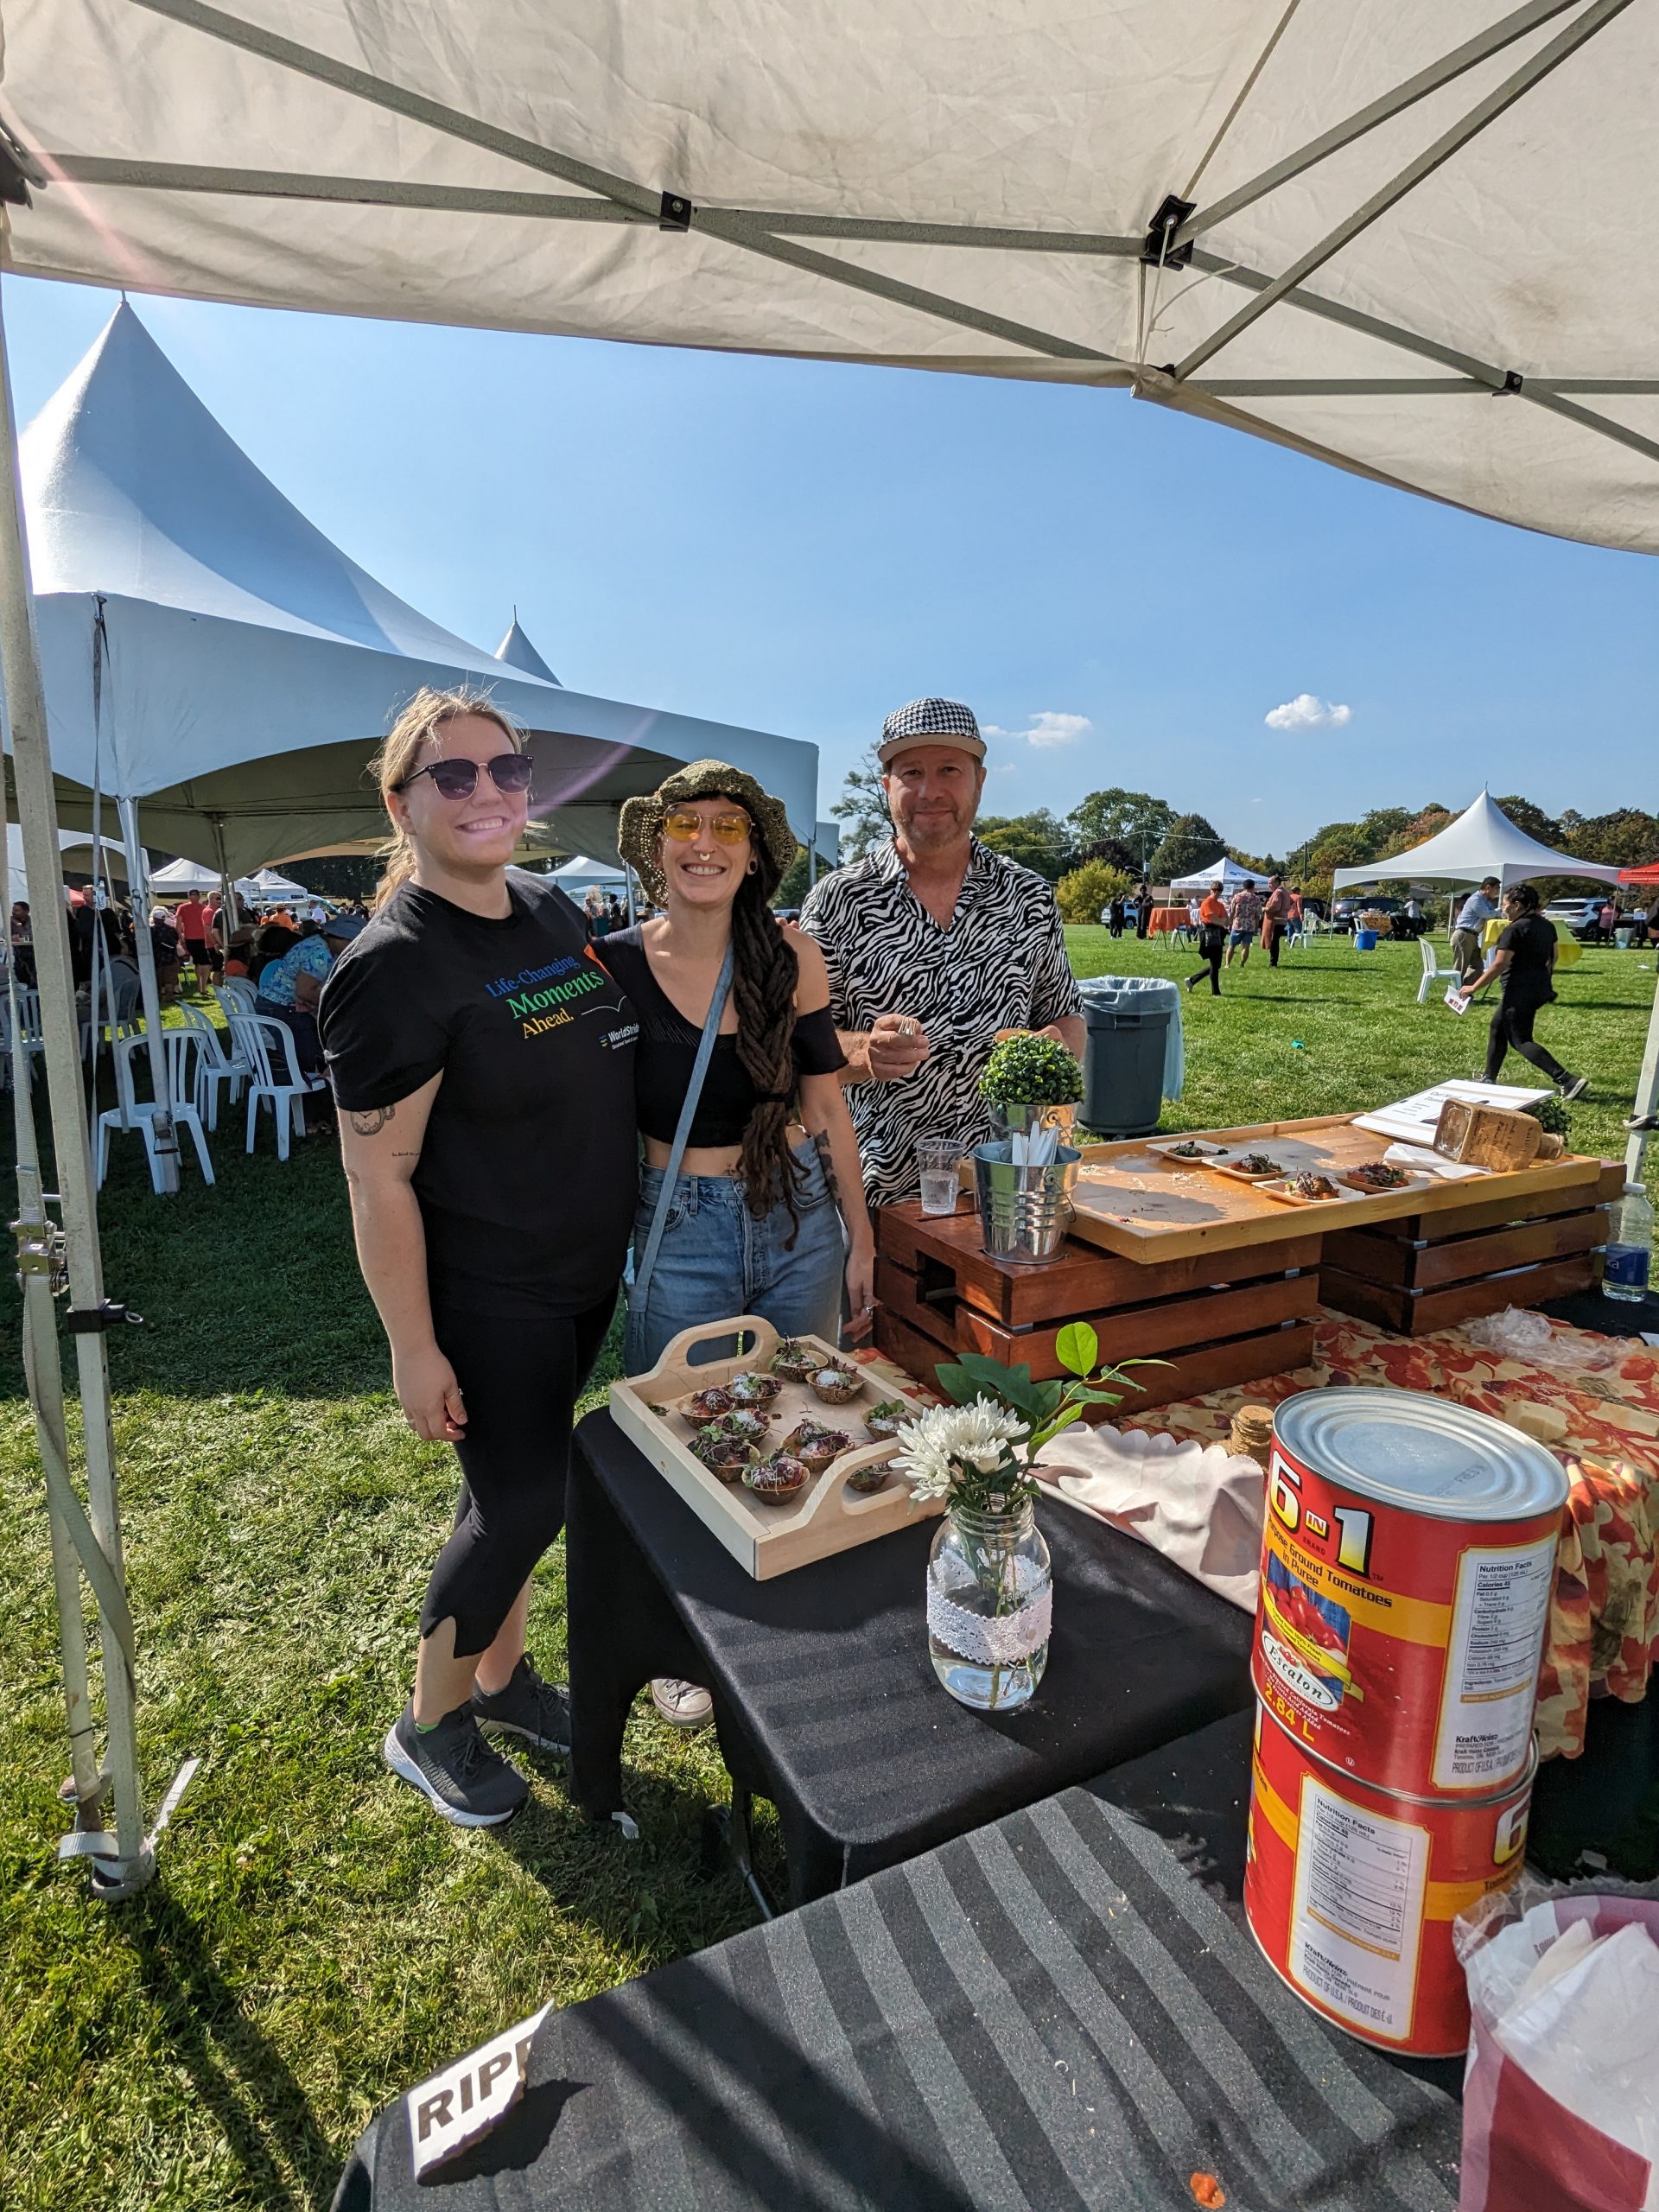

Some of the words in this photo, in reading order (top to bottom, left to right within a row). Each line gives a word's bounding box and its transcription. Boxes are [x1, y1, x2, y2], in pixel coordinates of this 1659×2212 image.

[484, 956, 582, 998] Life-Changing
[505, 971, 604, 1020] Moments
[523, 1007, 574, 1039] Ahead.
[607, 1023, 640, 1043] WorldStride
[1270, 1450, 1301, 1533] 6
[1306, 1511, 1325, 1532] IN
[1333, 1506, 1373, 1578] 1
[1303, 1536, 1325, 1556] BRAND
[1515, 1561, 1533, 1570] Facts
[1290, 1546, 1324, 1576] Ground
[1326, 1569, 1393, 1608] Tomatoes
[1291, 1560, 1319, 1588] Puree
[1269, 1644, 1322, 1700] Escalon
[1264, 1682, 1296, 1726] 2.84
[1301, 1719, 1315, 1743] L
[1289, 1691, 1319, 1716] California
[1319, 1713, 1351, 1736] Tomatoes
[1300, 1707, 1319, 1723] Added
[1302, 1714, 1322, 1731] Added
[1317, 1797, 1351, 1823] Nutrition
[1352, 1819, 1376, 1834] Facts
[1493, 1787, 1529, 1865] 6
[1303, 1964, 1324, 1986] PRODUCT
[1347, 1996, 1370, 2015] PRODUIT
[1370, 2006, 1382, 2020] DES
